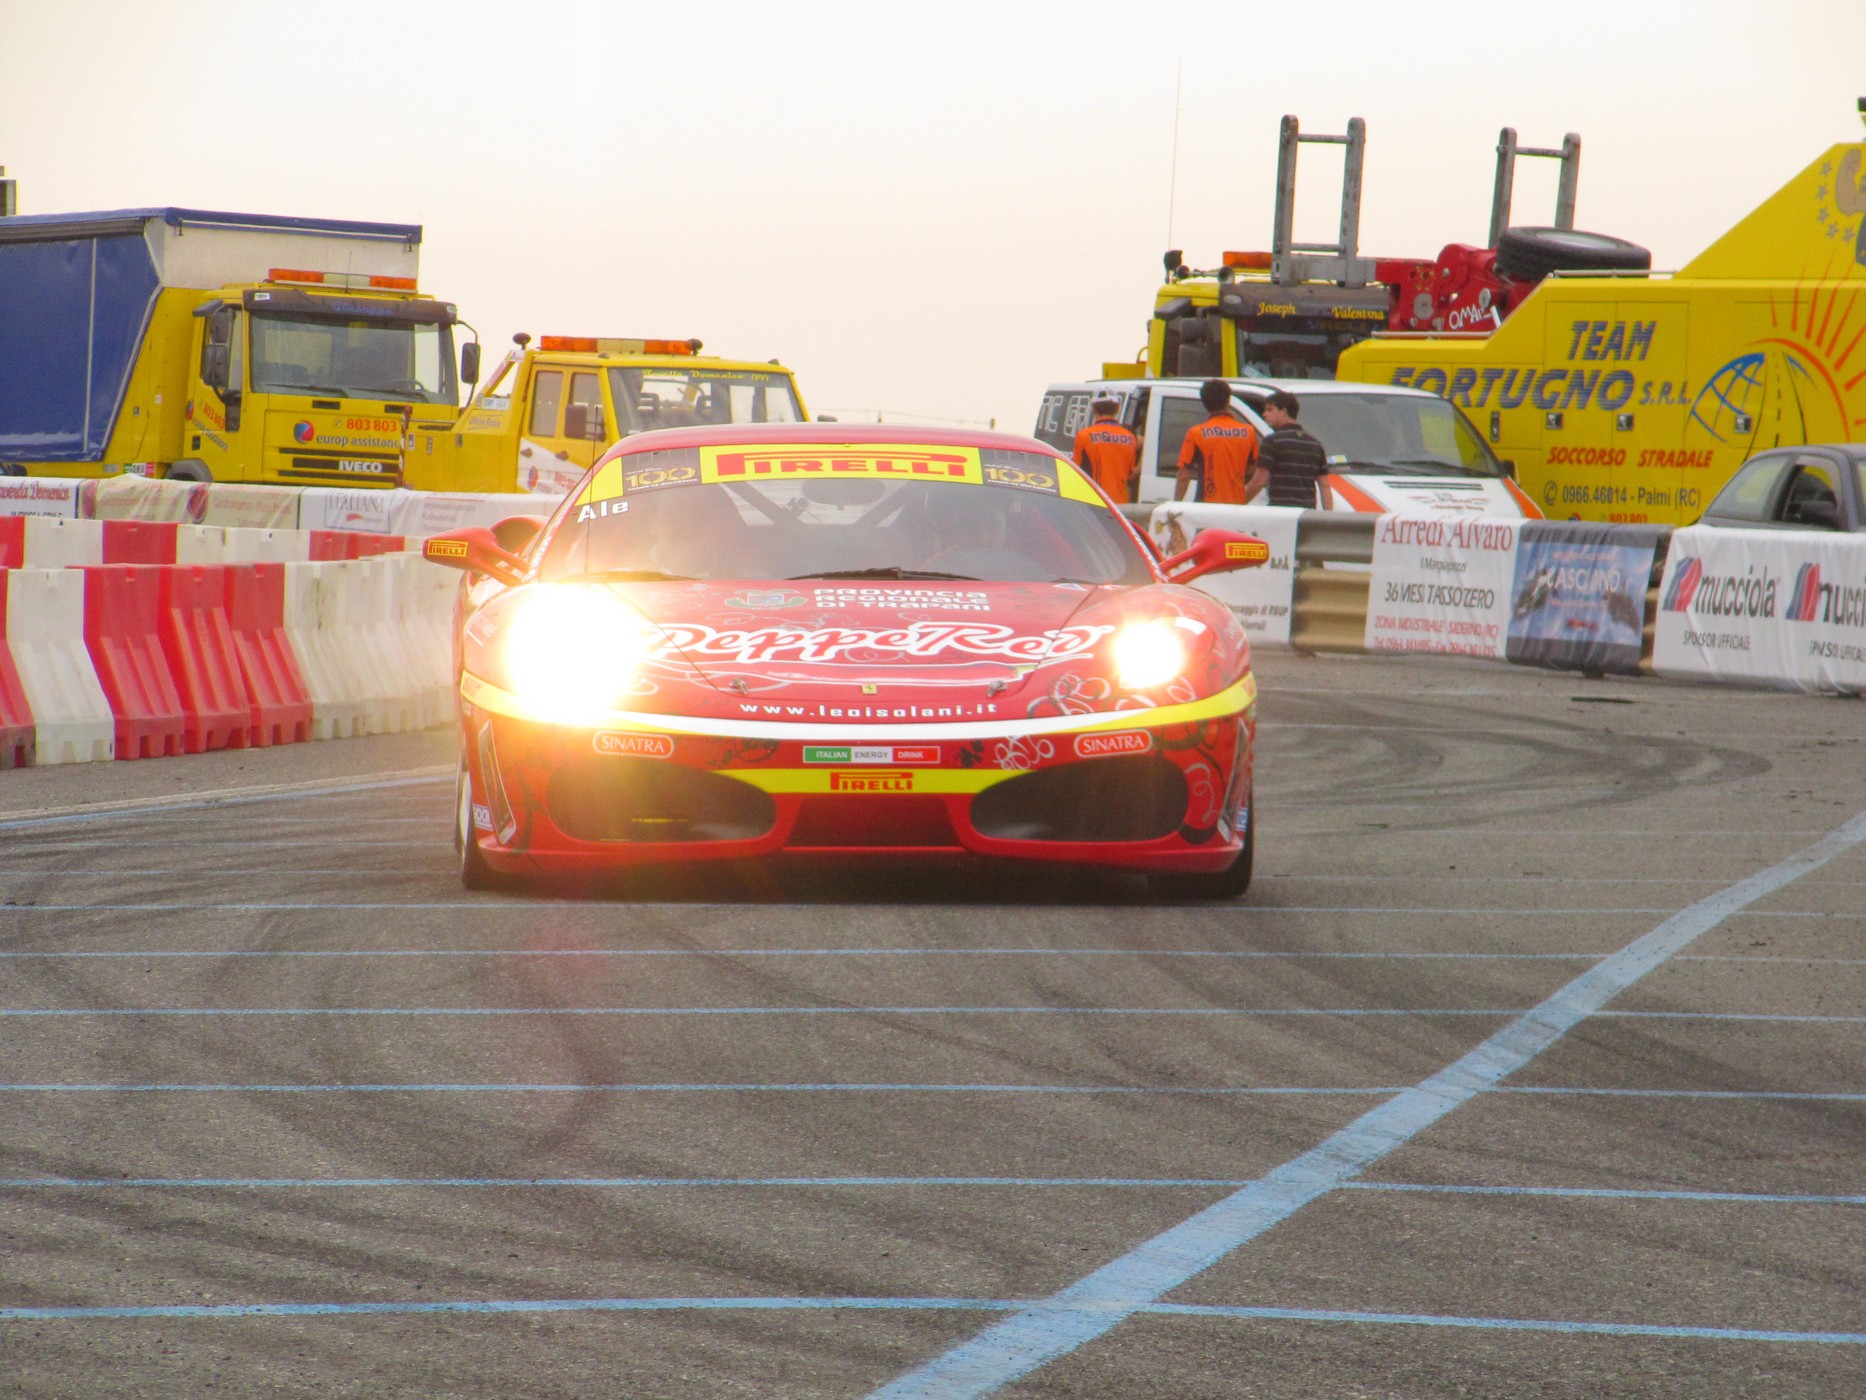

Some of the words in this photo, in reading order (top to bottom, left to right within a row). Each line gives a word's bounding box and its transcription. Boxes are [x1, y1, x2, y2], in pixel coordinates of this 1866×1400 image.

[1257, 302, 1296, 318] Joseph
[1332, 306, 1385, 320] Valentina
[1567, 321, 1657, 361] TEAM
[1390, 367, 1635, 410] FORTUGNO
[346, 418, 371, 431] 803
[373, 419, 397, 432] 803
[317, 435, 349, 447] europ
[352, 436, 400, 449] assistanc
[339, 460, 383, 473] IVECO
[716, 450, 968, 476] PIRELLI
[1546, 446, 1626, 465] SOCCORSO
[1638, 450, 1713, 468] STRADALE
[625, 467, 696, 487] 100
[984, 468, 1054, 488] 100
[1638, 487, 1670, 506] Palmi
[1674, 488, 1701, 511] (RC)
[577, 501, 629, 523] Ale
[1447, 516, 1513, 551] Alvaro
[428, 541, 467, 556] PIRELLI
[1226, 544, 1266, 558] PIRELLI
[1385, 581, 1398, 602] 36
[1427, 584, 1462, 607] TASSO
[1463, 588, 1495, 609] ZERO
[1695, 564, 1777, 618] mucciola
[602, 735, 665, 753] SINATRA
[1083, 734, 1145, 753] SINATRA
[816, 751, 847, 759] ITALIAN
[855, 751, 888, 759] ENERGY
[898, 751, 923, 759] DRINK
[830, 772, 913, 790] PIRELLI
